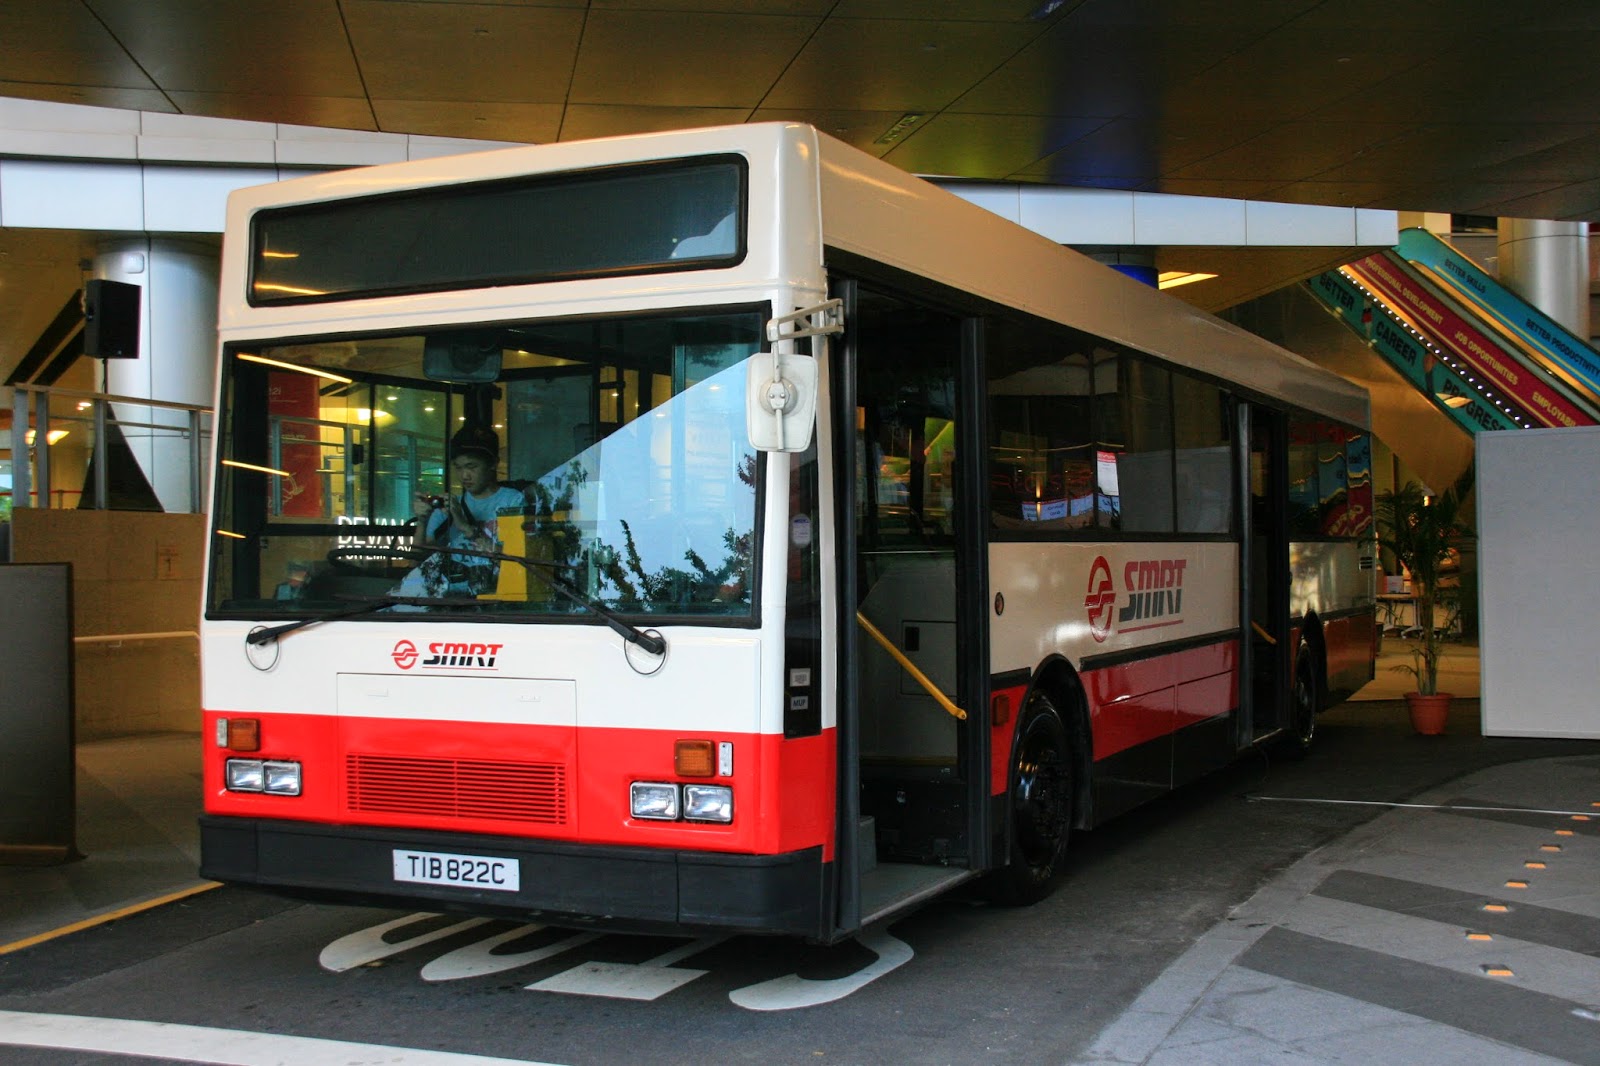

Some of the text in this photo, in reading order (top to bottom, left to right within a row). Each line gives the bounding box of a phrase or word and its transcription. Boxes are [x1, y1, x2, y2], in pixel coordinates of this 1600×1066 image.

[1365, 257, 1443, 324] PROFESSIONAL DEVELOPMENT
[1444, 259, 1486, 293] BETTER SKILLS
[1318, 273, 1507, 431] BETTER CAREER PRGRES
[1455, 331, 1468, 345] JOB
[1468, 341, 1518, 385] OPPORTUNITIES
[1525, 318, 1600, 376] BETTER PRODUCTIVITY
[1118, 559, 1187, 622] SMRT
[422, 642, 503, 668] SMRT
[407, 855, 505, 884] TIB822C
